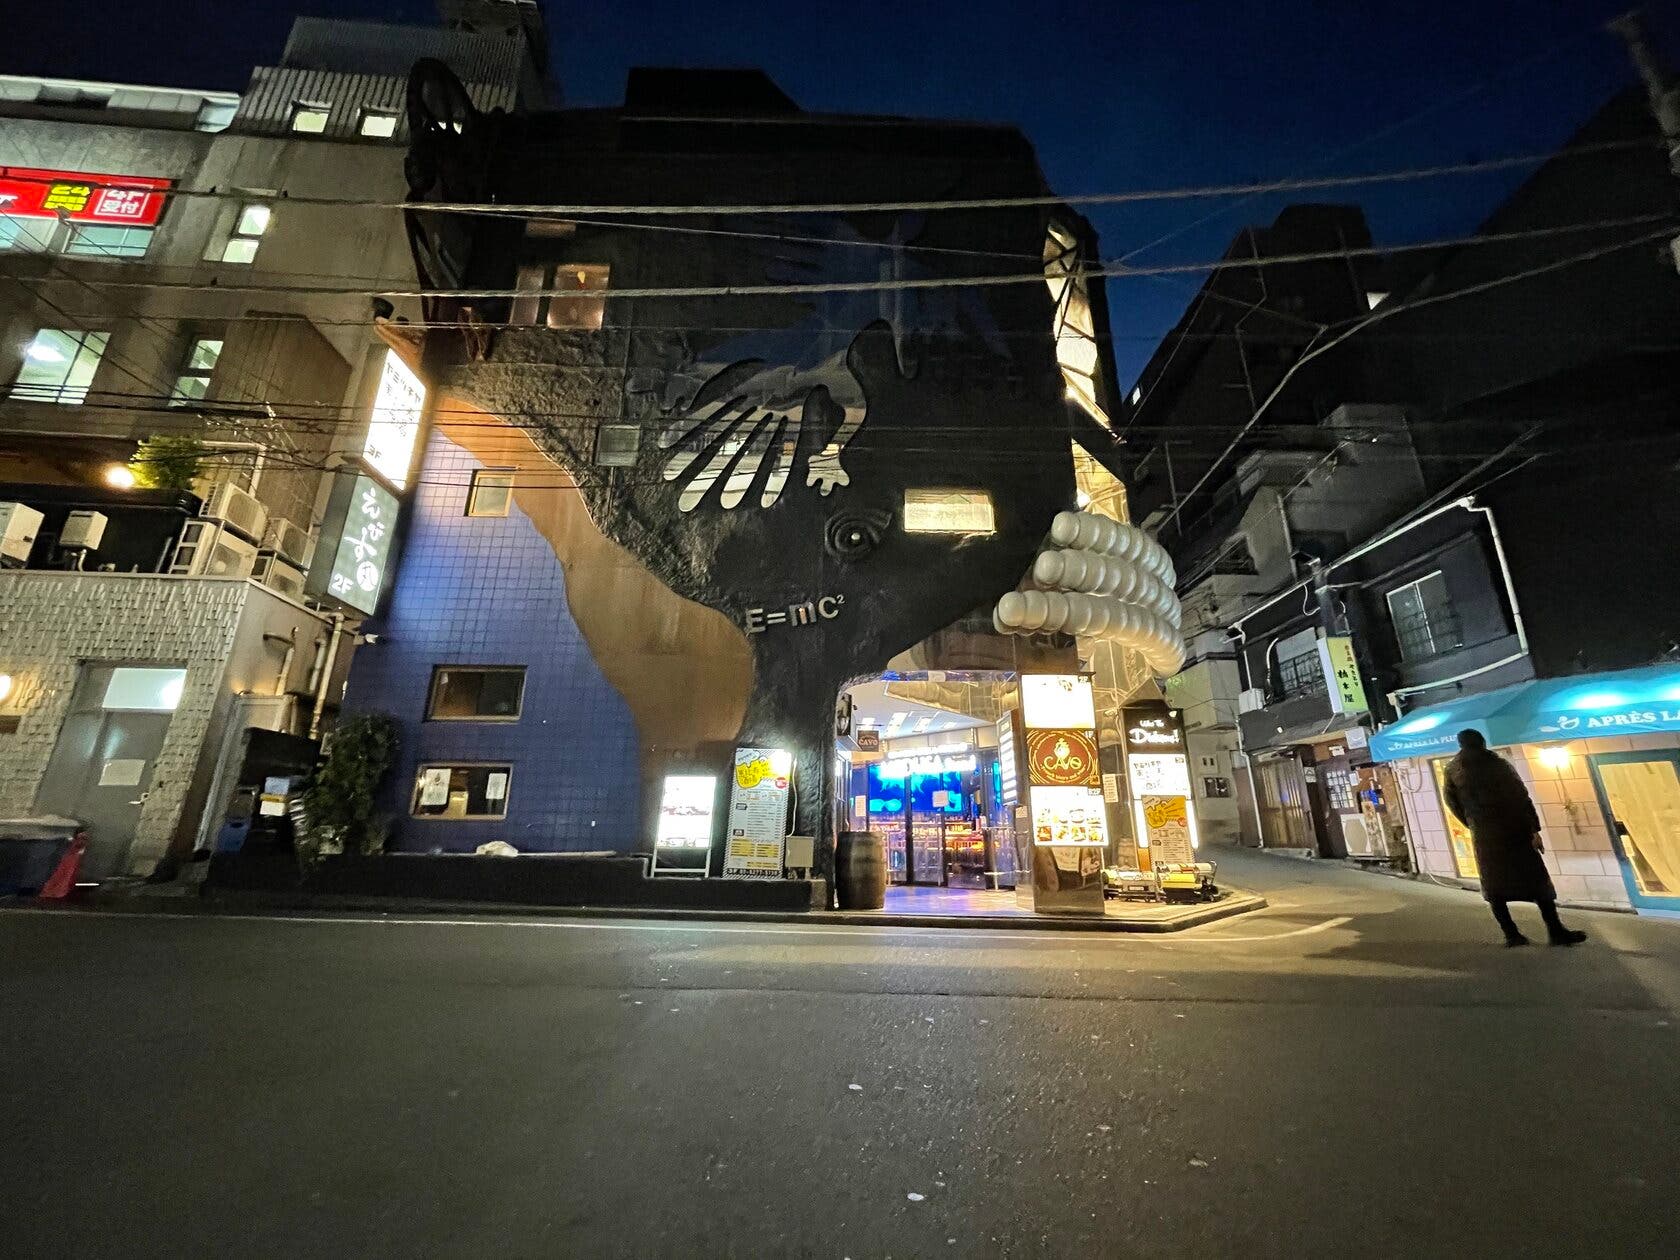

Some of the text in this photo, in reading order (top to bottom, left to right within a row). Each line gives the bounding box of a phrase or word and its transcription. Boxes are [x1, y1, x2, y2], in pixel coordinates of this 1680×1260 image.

[331, 572, 354, 594] 2F
[1587, 710, 1657, 728] APRÈS
[1044, 755, 1082, 770] CAVO
